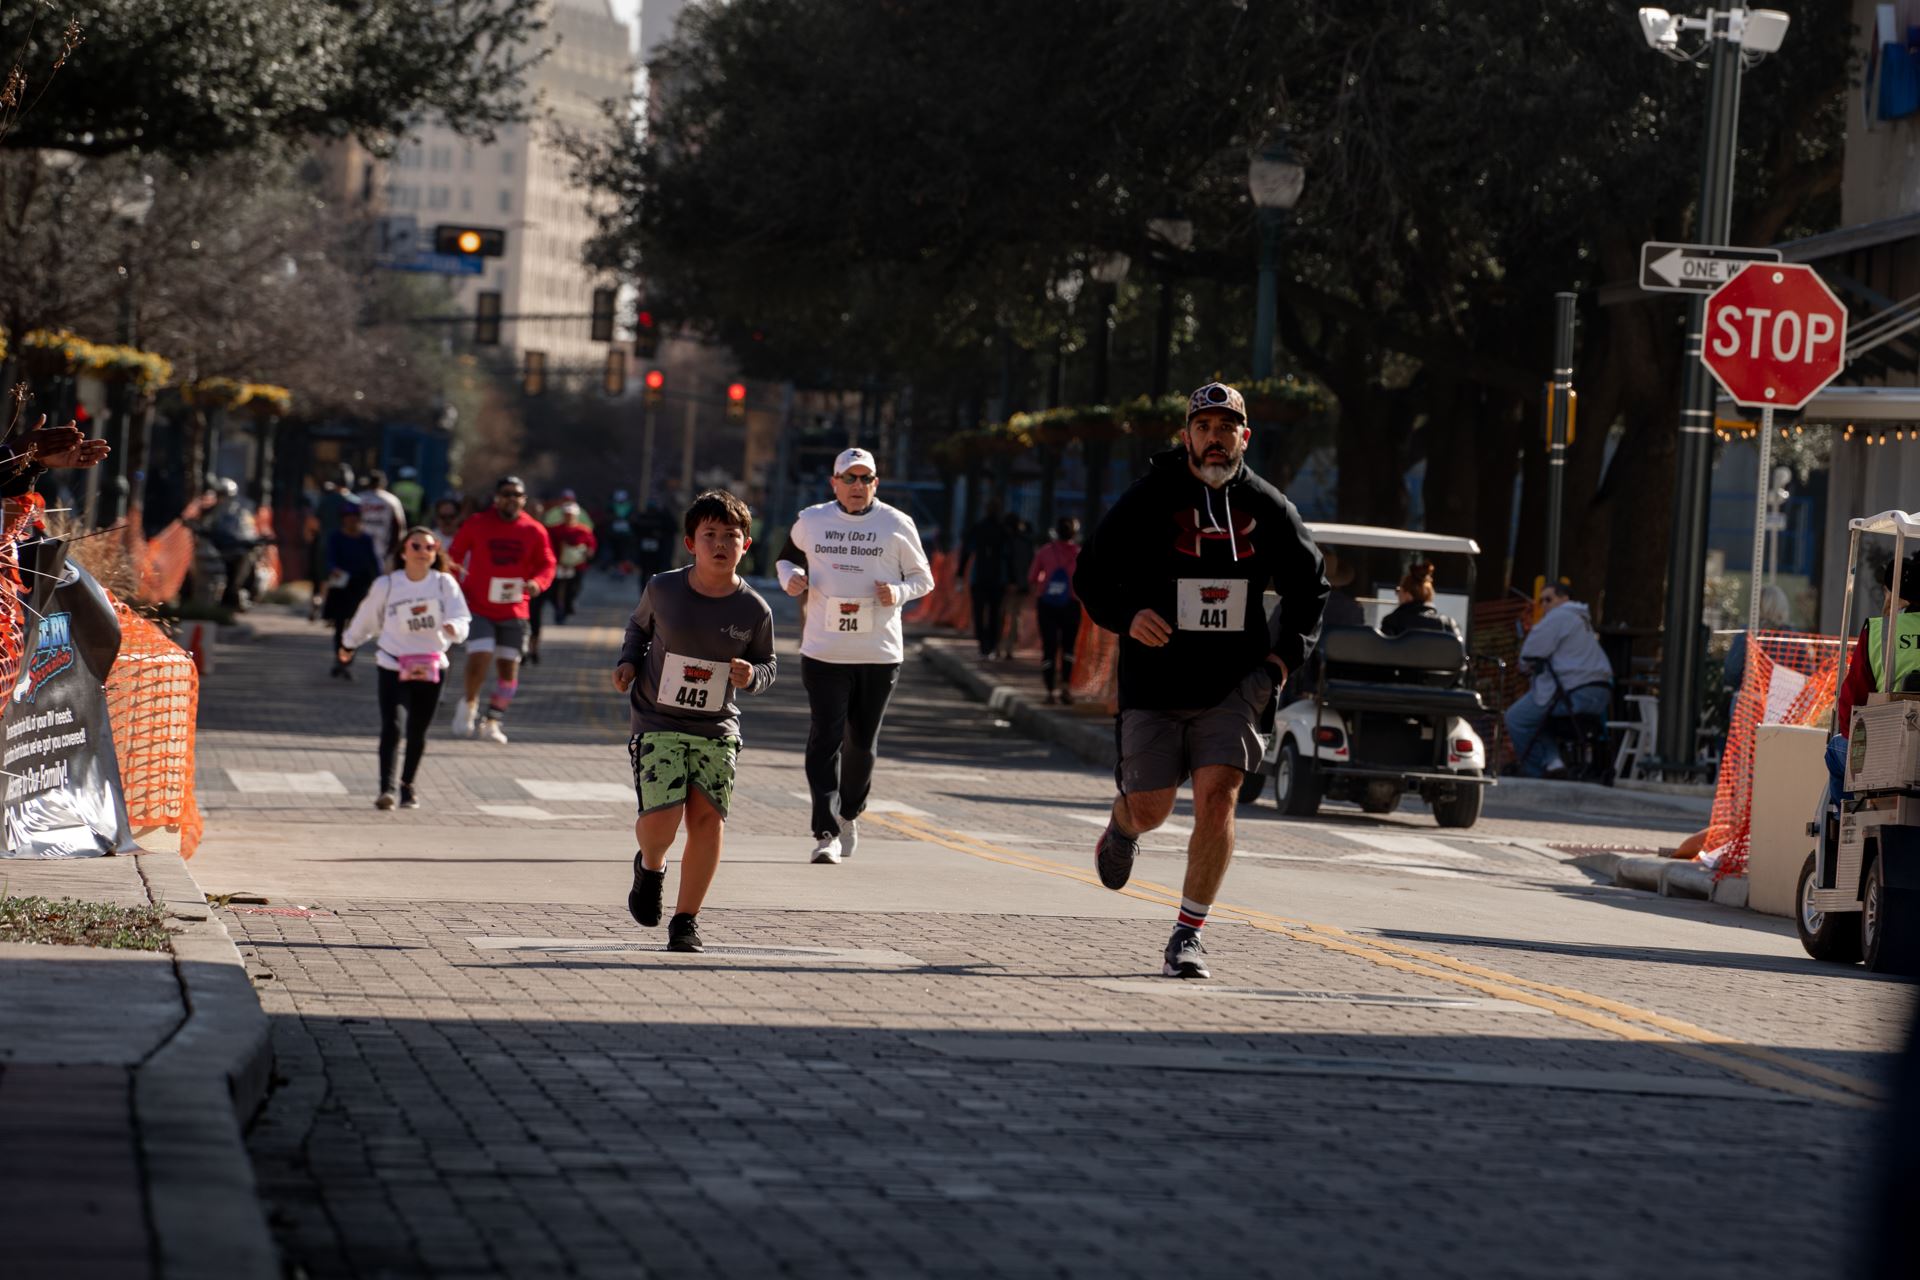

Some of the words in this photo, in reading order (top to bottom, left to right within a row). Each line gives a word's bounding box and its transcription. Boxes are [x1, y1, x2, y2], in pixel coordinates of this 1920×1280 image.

[1683, 259, 1719, 277] ONE
[1712, 305, 1835, 364] STOP
[825, 530, 845, 541] Why
[848, 531, 865, 541] (Do
[866, 532, 877, 542] I)
[815, 544, 848, 555] Donate
[850, 545, 884, 557] Blood?
[838, 618, 858, 632] 214
[1200, 609, 1227, 628] 441
[675, 686, 708, 708] 443
[40, 759, 68, 792] Family!
